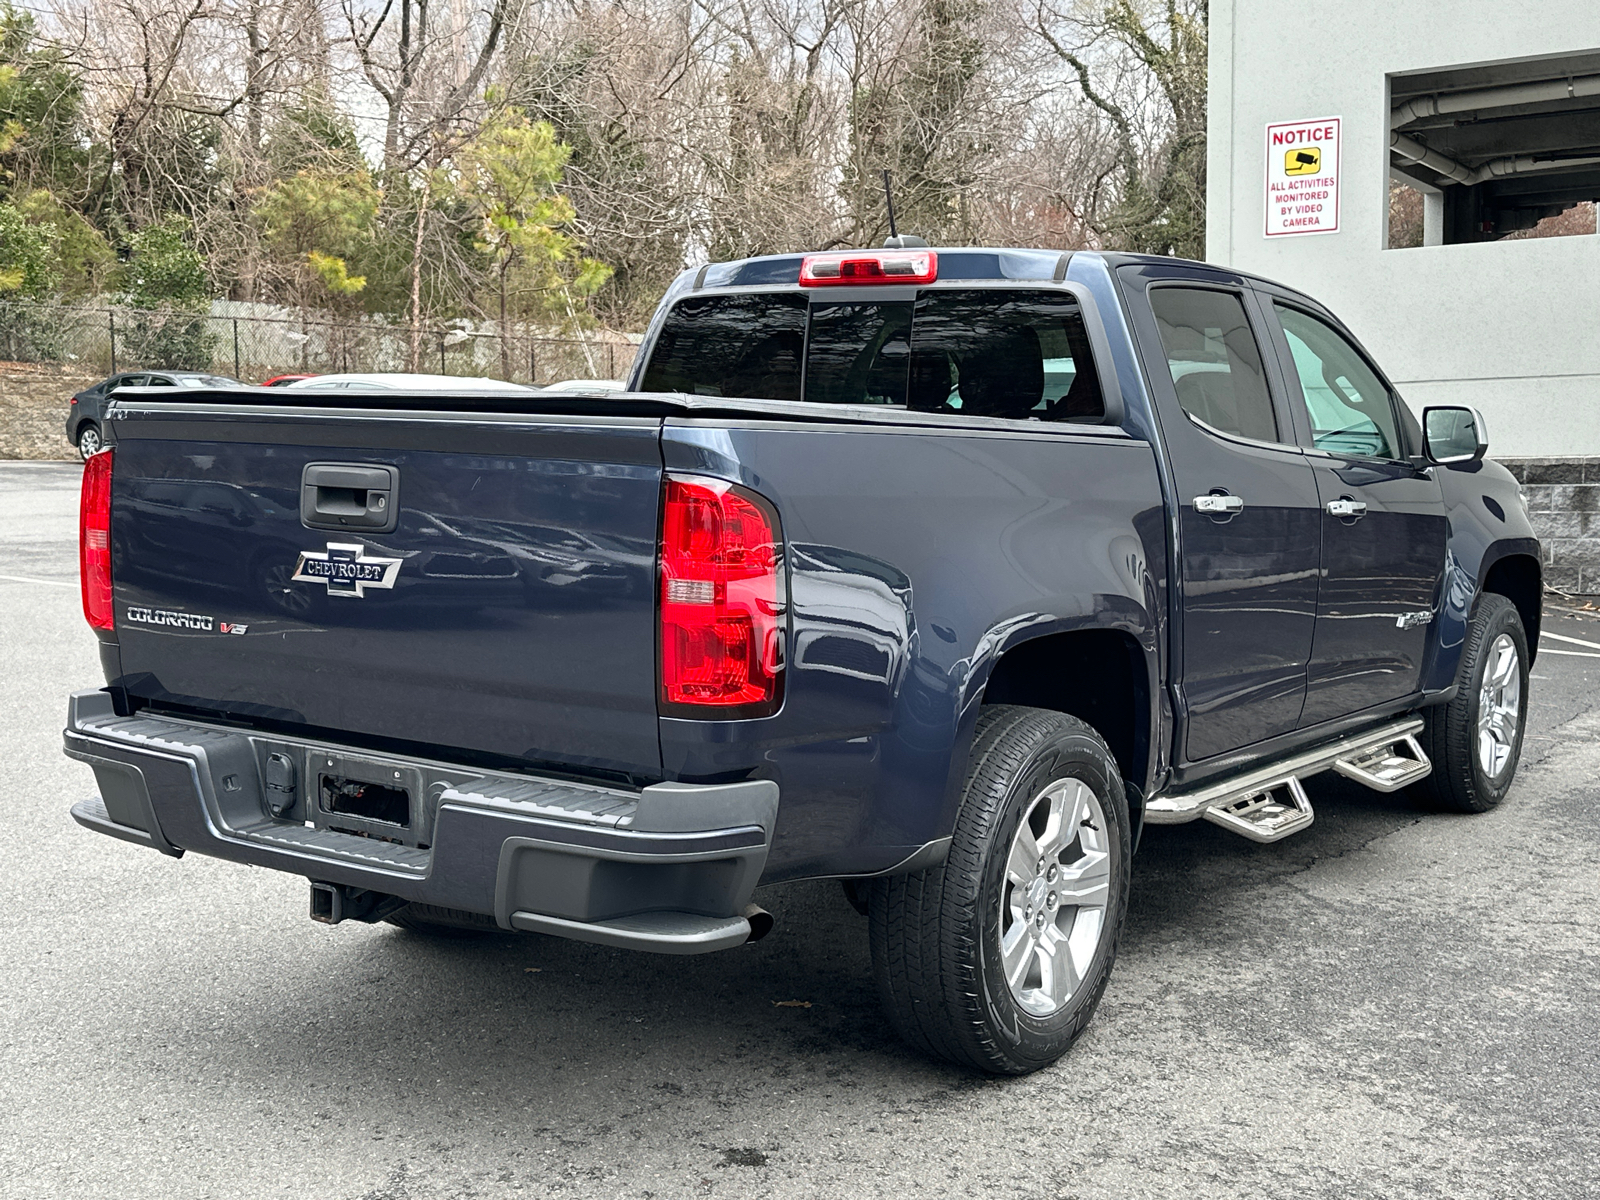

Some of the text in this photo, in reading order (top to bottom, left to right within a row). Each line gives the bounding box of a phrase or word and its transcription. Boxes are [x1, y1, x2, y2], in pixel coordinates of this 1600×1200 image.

[1273, 127, 1334, 145] NOTICE
[1270, 177, 1335, 191] ALL ACTIVITIES
[1275, 191, 1328, 203] MONITORED
[1281, 204, 1323, 215] BY VIDEO
[1283, 216, 1320, 227] CAMERA
[307, 560, 382, 580] CHEVROLET
[127, 606, 249, 636] COLORADO V6
